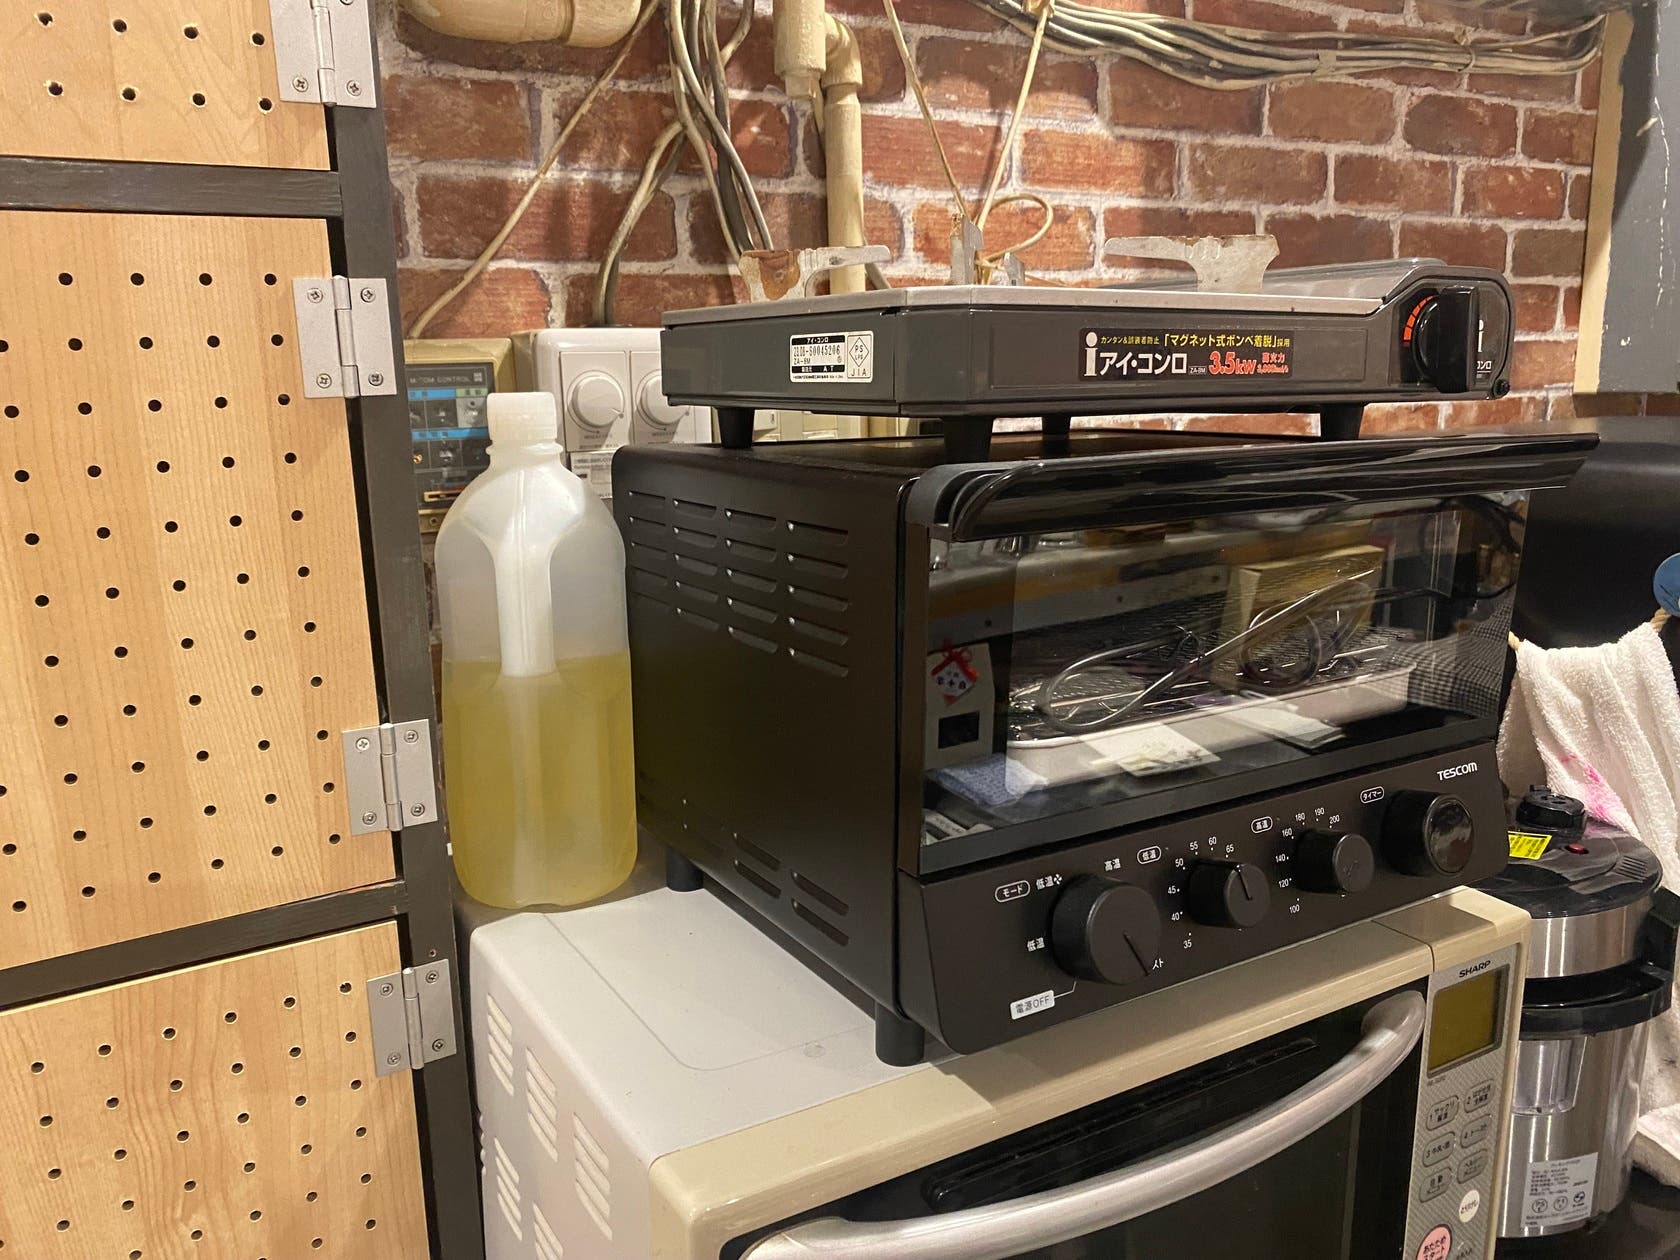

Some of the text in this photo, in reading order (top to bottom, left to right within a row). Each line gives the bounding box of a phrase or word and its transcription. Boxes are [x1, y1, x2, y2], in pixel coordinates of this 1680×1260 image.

[1100, 351, 1188, 376] アイ・コンロ
[1208, 350, 1257, 375] 3.5kW
[851, 368, 867, 377] JIA
[1436, 762, 1478, 781] TESCOM
[1362, 790, 1383, 801] タイマー
[1314, 807, 1325, 816] 190
[1295, 812, 1306, 822] 180
[1328, 814, 1340, 825] 200
[1281, 827, 1293, 838] 160
[1189, 841, 1199, 851] 55
[1208, 836, 1217, 846] 60
[1225, 843, 1235, 853] 65
[1175, 858, 1184, 868] 50
[1275, 853, 1286, 863] 140
[1104, 858, 1121, 872] 高温
[1035, 875, 1054, 890] 低温
[1278, 878, 1289, 888] 120
[1003, 884, 1023, 897] モード
[1167, 885, 1177, 895] 45
[1289, 904, 1300, 914] 100
[1171, 912, 1180, 921] 40
[1026, 937, 1045, 952] 低温
[1183, 939, 1192, 949] 35
[1458, 960, 1491, 978] SHARP
[1015, 995, 1051, 1015] 電源OFF
